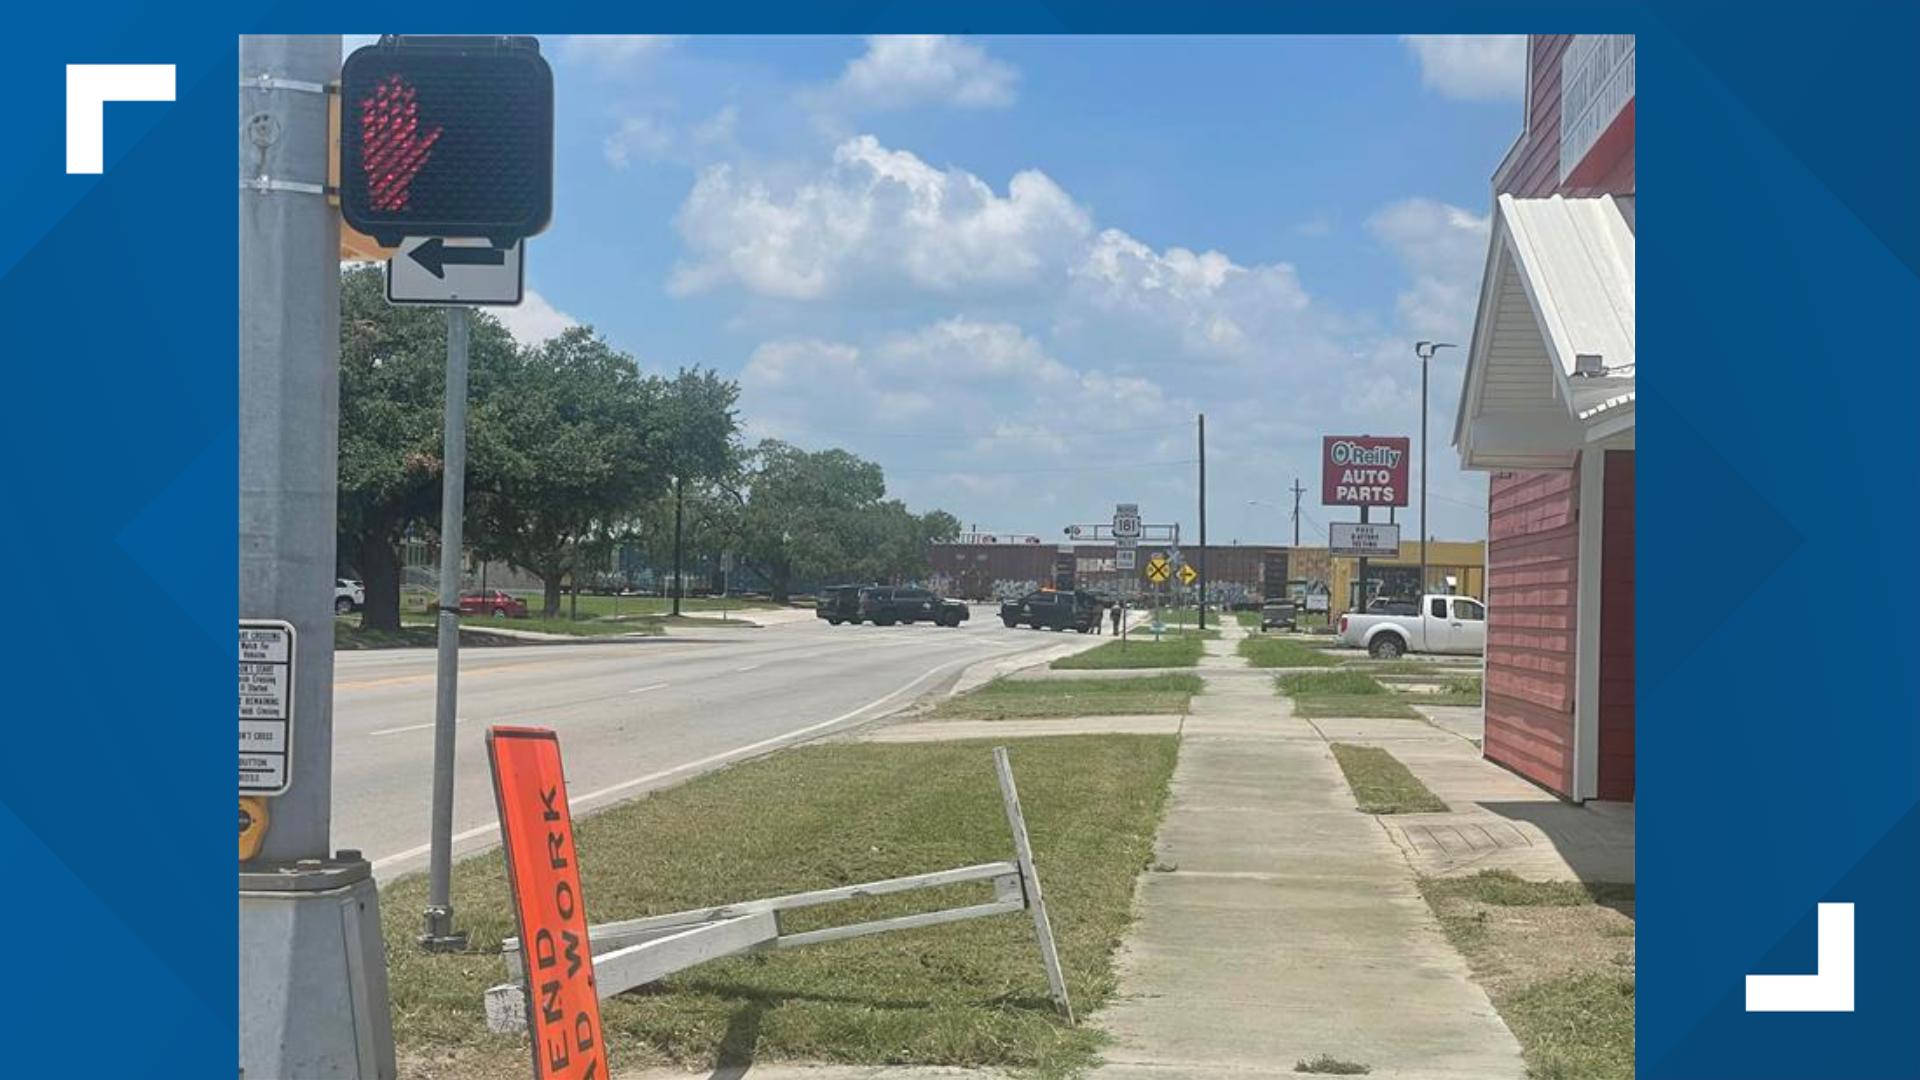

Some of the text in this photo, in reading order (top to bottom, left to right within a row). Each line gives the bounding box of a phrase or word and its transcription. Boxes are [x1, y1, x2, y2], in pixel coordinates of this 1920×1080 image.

[1332, 441, 1401, 468] O'Reilly
[1342, 470, 1390, 484] AUTO
[1336, 486, 1394, 502] PARTS
[1119, 519, 1135, 532] 181
[540, 786, 582, 979] WORK
[534, 928, 569, 1073] END
